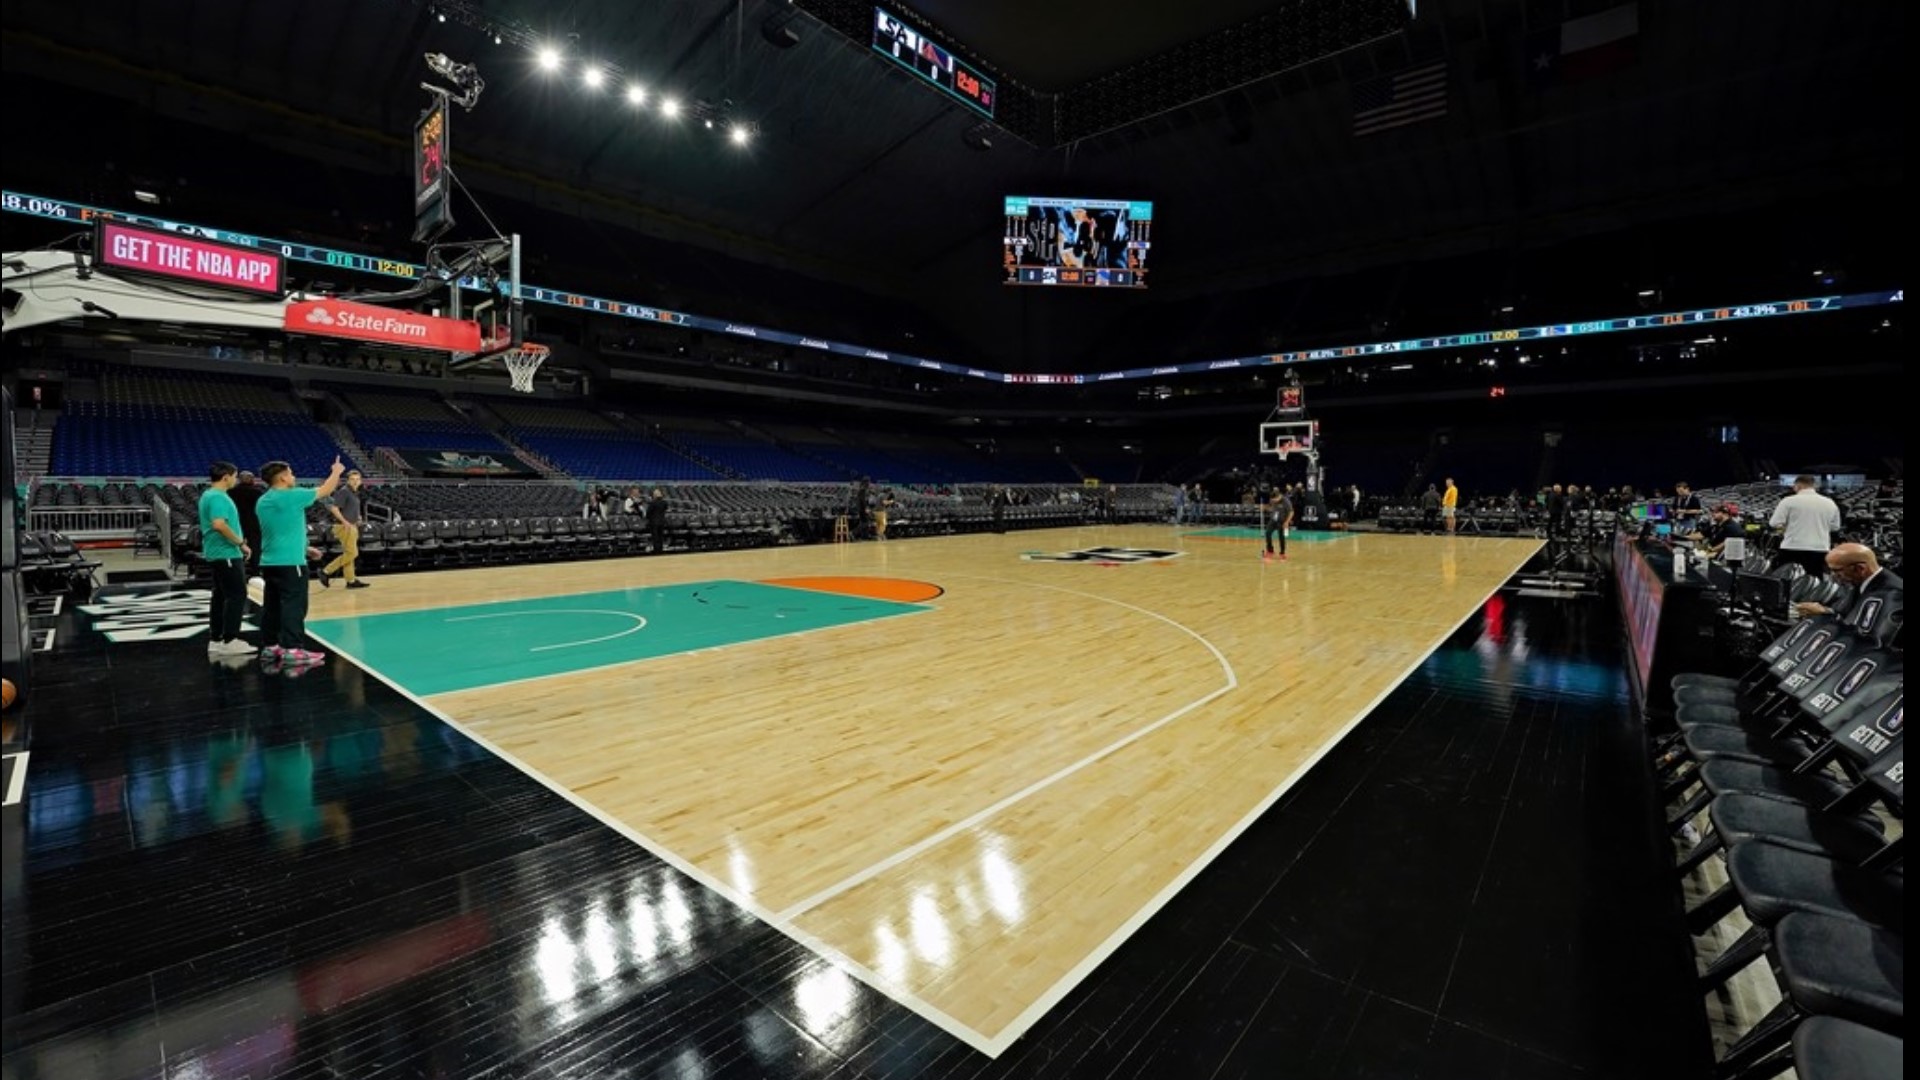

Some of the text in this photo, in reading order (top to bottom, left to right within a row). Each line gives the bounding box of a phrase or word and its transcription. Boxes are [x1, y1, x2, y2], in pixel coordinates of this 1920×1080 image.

[893, 41, 900, 57] 0
[931, 65, 938, 79] 0
[282, 245, 292, 257] 0
[113, 234, 272, 284] GET THE NBA APP
[377, 259, 414, 278] 12:00
[535, 289, 543, 300] 0
[1733, 304, 1777, 318] 43.3%
[1820, 298, 1831, 310] 7
[1627, 318, 1636, 329] 0
[1489, 386, 1505, 398] 24
